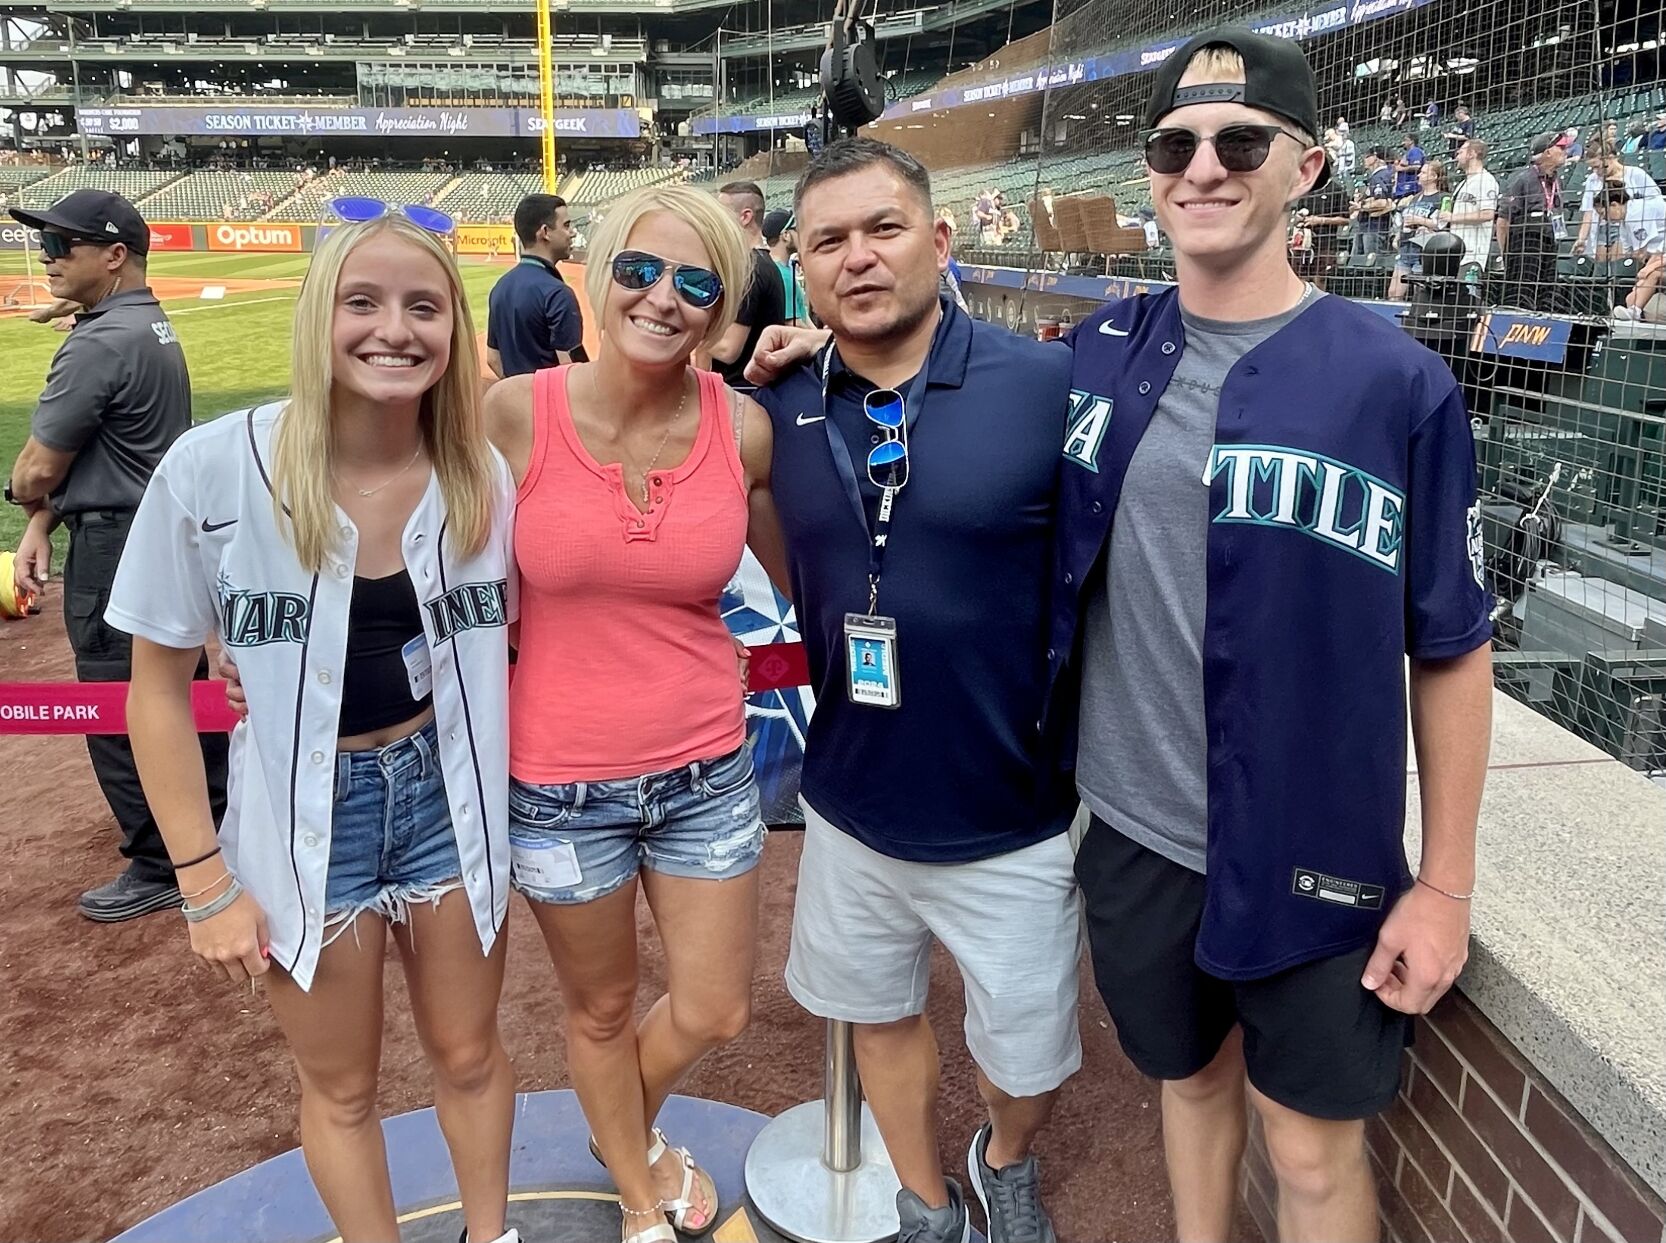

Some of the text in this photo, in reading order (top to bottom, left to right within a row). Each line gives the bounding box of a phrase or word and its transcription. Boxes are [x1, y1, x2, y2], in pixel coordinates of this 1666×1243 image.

[205, 111, 468, 135] SEASON TICKET MEMBER Appreciation Night
[527, 116, 587, 132] SEAGEEK
[216, 224, 293, 250] Optum
[1498, 323, 1552, 349] PNW
[423, 578, 508, 648] INE
[53, 704, 100, 720] PARK
